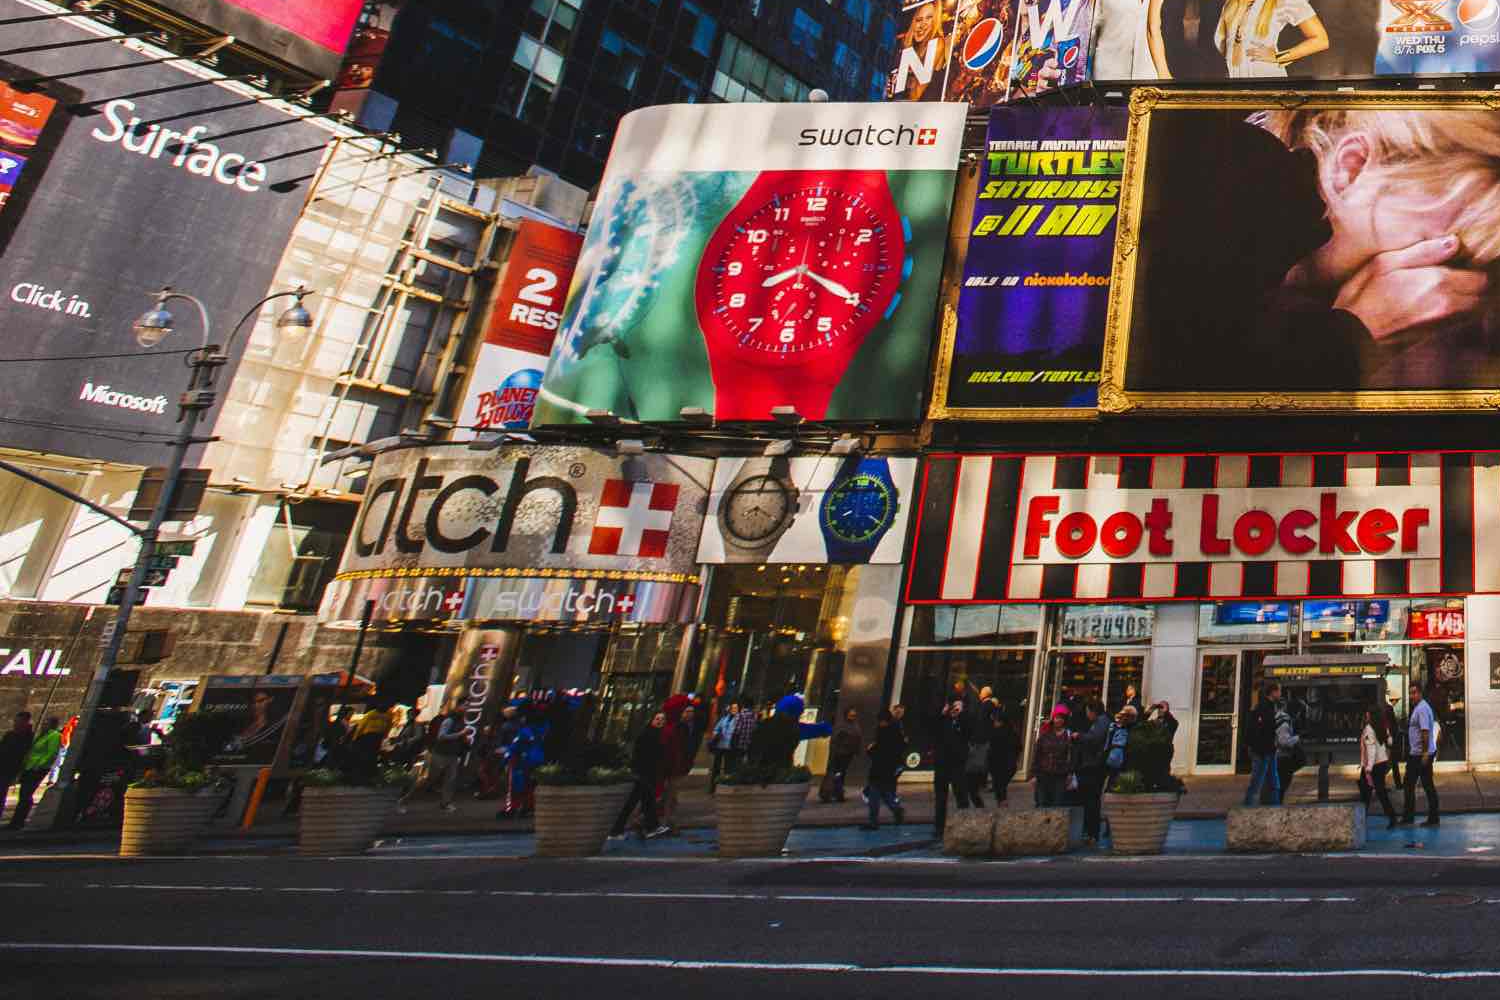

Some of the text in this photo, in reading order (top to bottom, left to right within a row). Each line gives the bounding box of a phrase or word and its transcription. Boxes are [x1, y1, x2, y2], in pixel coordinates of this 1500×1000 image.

[1460, 34, 1500, 46] pepsi
[799, 124, 916, 147] swatch
[91, 99, 267, 192] Surface
[979, 180, 1121, 198] SATURDAYS
[806, 197, 828, 212] 12
[775, 207, 790, 221] 11
[1036, 205, 1117, 236] AM
[746, 229, 769, 243] 10
[857, 229, 873, 243] 2
[728, 262, 742, 276] 9
[518, 268, 558, 306] 2
[965, 276, 1000, 287] ONLY
[10, 282, 92, 319] Click in.
[729, 293, 746, 308] 8
[509, 303, 561, 330] RES
[747, 317, 764, 332] 7
[817, 317, 832, 332] 5
[779, 328, 795, 342] 6
[80, 382, 169, 414] Microsoft
[1023, 492, 1430, 558] Foot Locker
[490, 589, 616, 613] swatch
